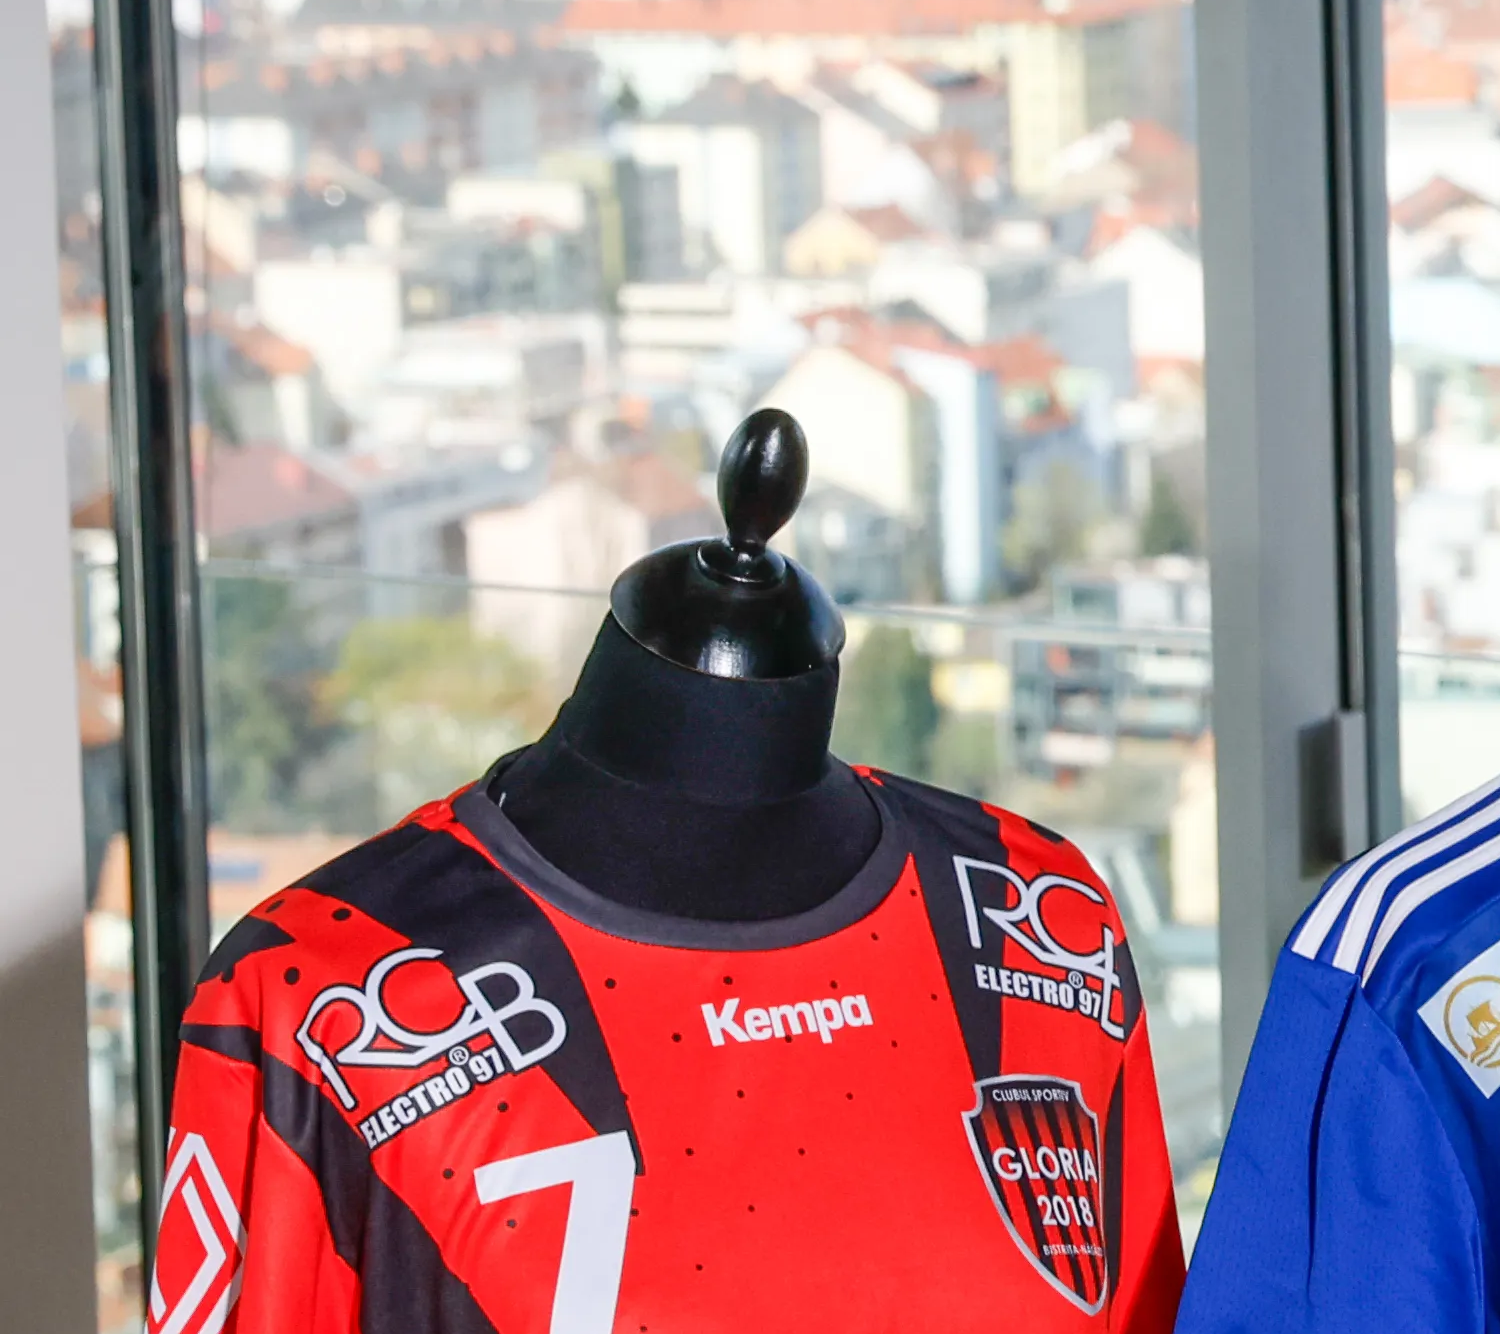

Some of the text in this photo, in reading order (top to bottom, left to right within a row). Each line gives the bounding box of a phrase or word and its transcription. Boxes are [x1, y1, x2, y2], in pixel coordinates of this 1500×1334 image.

[974, 963, 1075, 1010] ELECTRO
[701, 994, 874, 1047] Kempa
[359, 1066, 471, 1150] ELECTRO
[992, 1088, 1031, 1102] CLUBUL
[992, 1146, 1098, 1183] GLORIA
[1037, 1195, 1094, 1227] 2018
